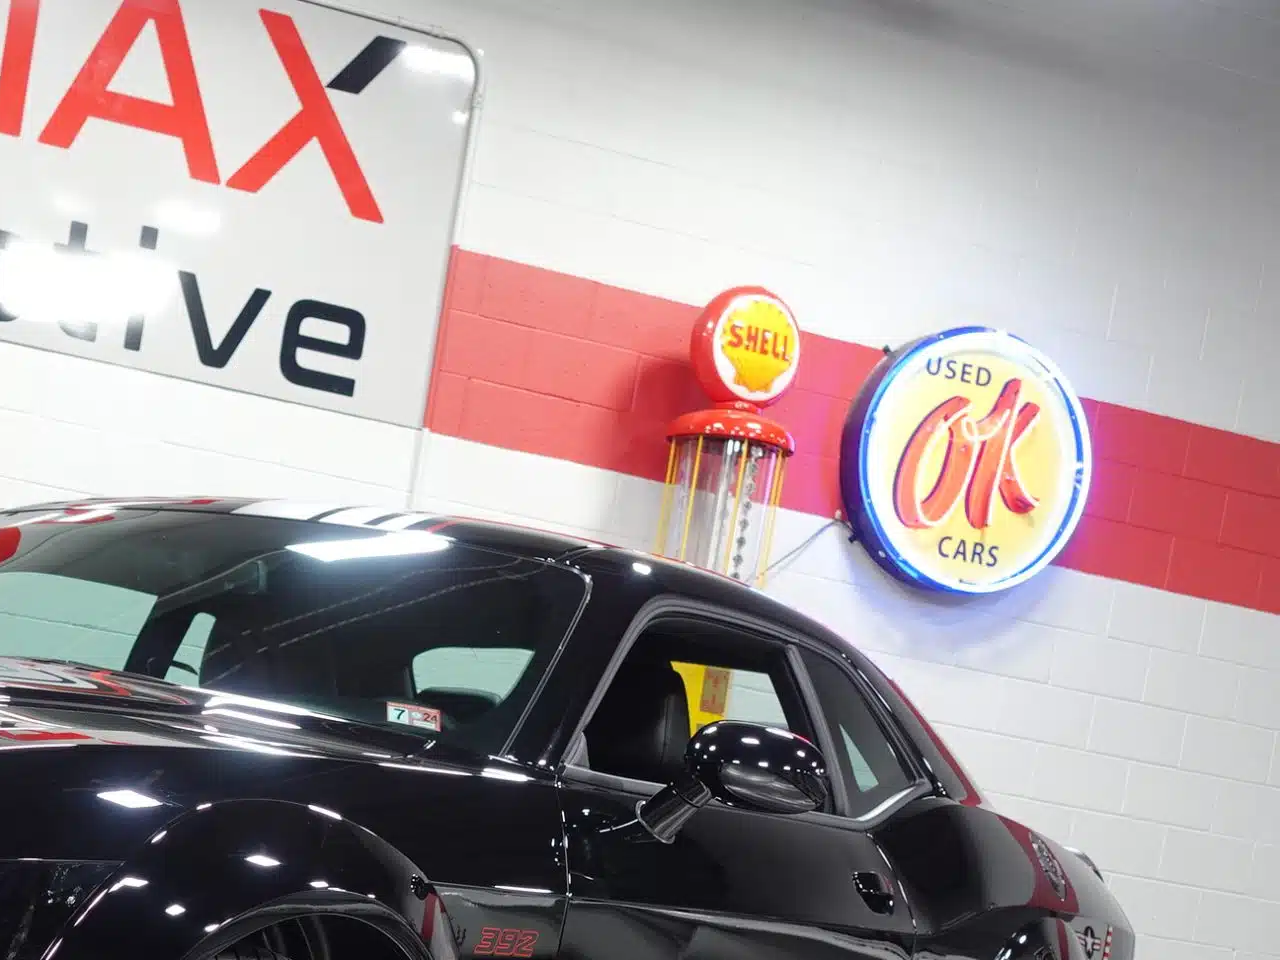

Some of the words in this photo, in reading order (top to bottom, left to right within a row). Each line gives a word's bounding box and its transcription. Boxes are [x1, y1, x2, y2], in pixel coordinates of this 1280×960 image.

[727, 324, 790, 362] SHELL
[926, 357, 992, 387] USED
[892, 378, 1041, 530] OK
[937, 536, 999, 568] CARS
[393, 707, 406, 720] 7
[423, 712, 438, 724] 24
[474, 927, 540, 958] 392
